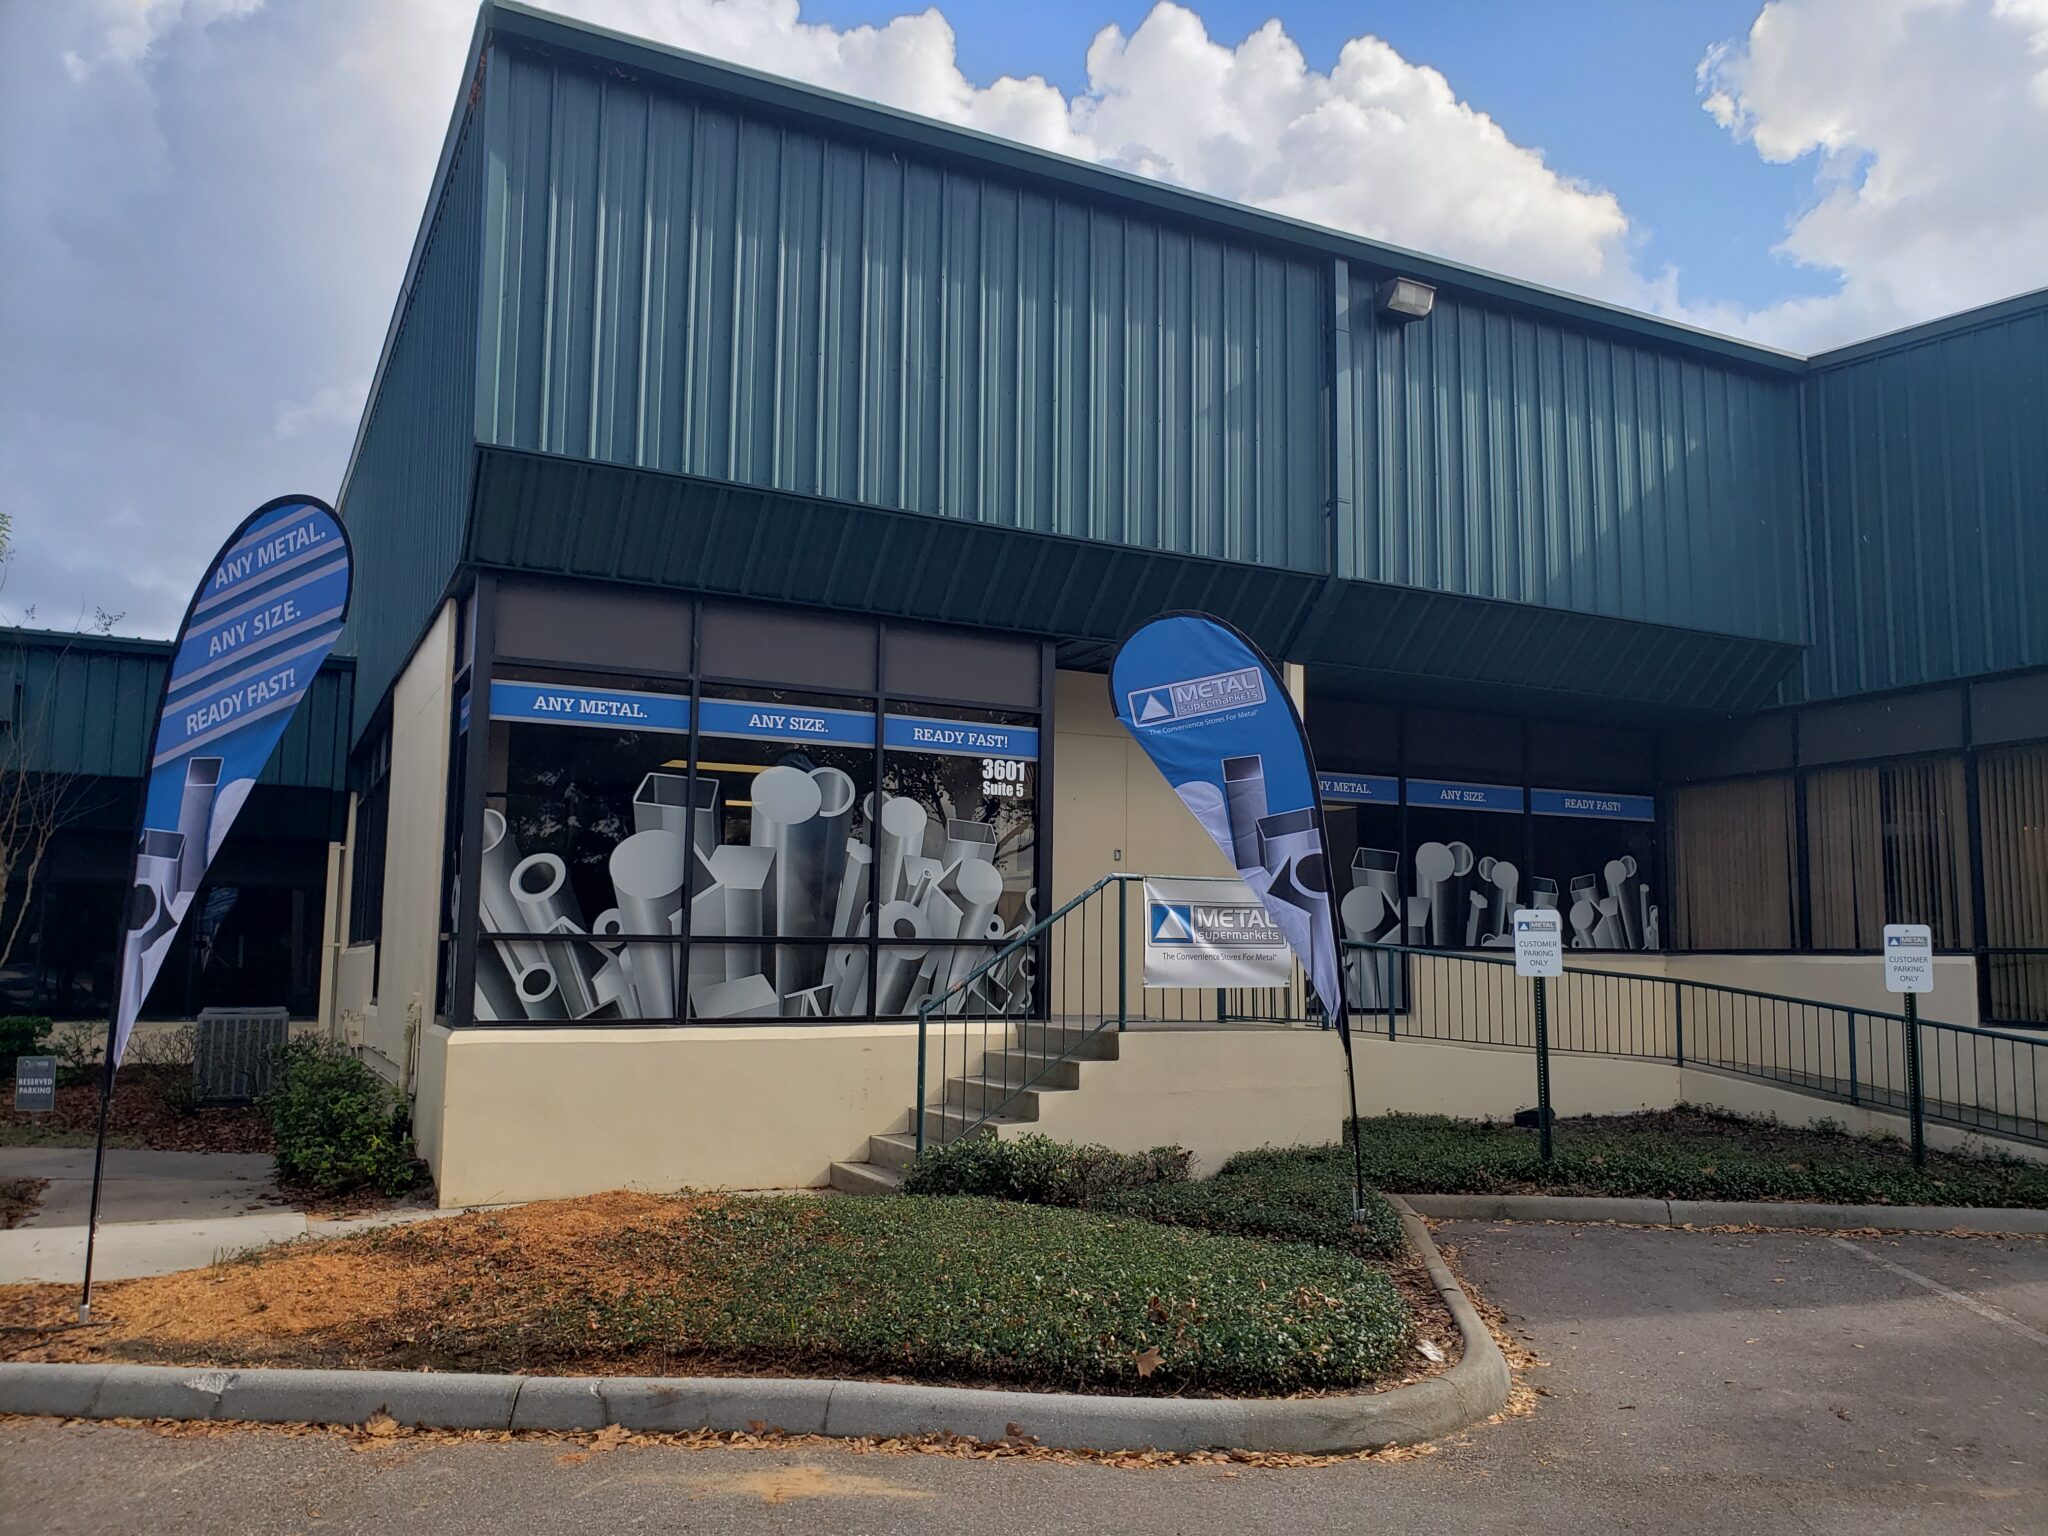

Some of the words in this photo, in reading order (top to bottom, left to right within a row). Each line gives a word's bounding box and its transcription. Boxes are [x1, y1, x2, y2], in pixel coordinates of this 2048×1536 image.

[215, 553, 253, 589] ANY
[258, 522, 326, 568] METAL.
[209, 621, 247, 657] ANY
[254, 600, 301, 636] SIZE.
[1176, 674, 1256, 702] METAL
[186, 691, 244, 736] READY
[247, 668, 296, 708] FAST!
[533, 695, 576, 713] ANY
[579, 698, 648, 718] METAL.
[1180, 690, 1258, 713] supermarkets
[749, 714, 786, 729] ANY
[789, 717, 829, 733] SIZE.
[1163, 721, 1204, 734] Convenience
[1205, 716, 1225, 725] Stores
[1226, 713, 1237, 721] For
[913, 727, 964, 744] READY
[967, 733, 1009, 748] FAST!
[982, 758, 1025, 782] 3601
[982, 780, 1014, 797] Suite
[1015, 783, 1024, 797] 5
[1319, 780, 1331, 791] NY
[1333, 781, 1372, 794] METAL.
[1440, 790, 1461, 801] ANY
[1463, 792, 1486, 802] SIZE.
[1564, 798, 1594, 810] READY
[1596, 800, 1621, 812] FAST!
[1197, 908, 1279, 929] METAL
[1198, 929, 1279, 942] supermarkets
[1519, 940, 1557, 948] CUSTOMER
[1162, 952, 1175, 961] The
[1176, 952, 1220, 961] Convenience
[1221, 952, 1242, 962] Stores
[1242, 953, 1254, 961] For
[1893, 965, 1925, 973] PARKING
[18, 1078, 52, 1086] RESERVED
